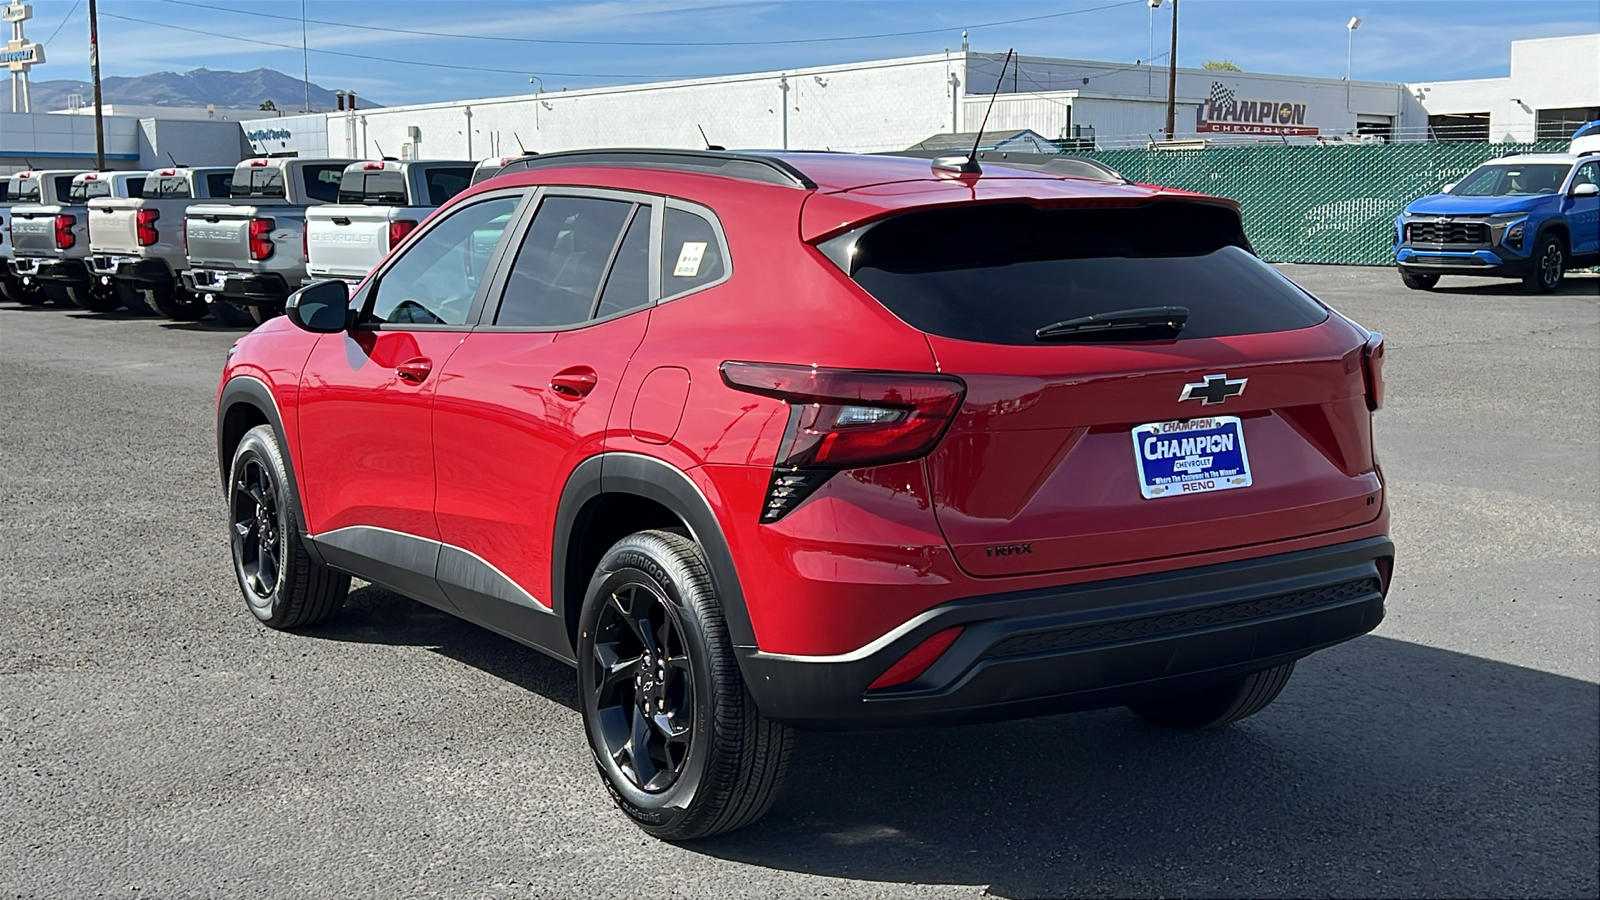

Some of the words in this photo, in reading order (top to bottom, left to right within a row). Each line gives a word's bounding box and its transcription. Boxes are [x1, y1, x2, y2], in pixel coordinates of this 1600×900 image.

[1196, 99, 1307, 127] CHAMPION
[1211, 124, 1300, 135] CHEVROLET
[188, 230, 239, 240] CHEVROLET
[311, 233, 376, 244] CHEVROLET
[1162, 418, 1213, 432] CHAMPION
[1144, 433, 1234, 460] CHAMPION
[1175, 458, 1211, 469] CHEVROLET
[1182, 480, 1215, 492] RENO
[984, 543, 1033, 557] TRAX
